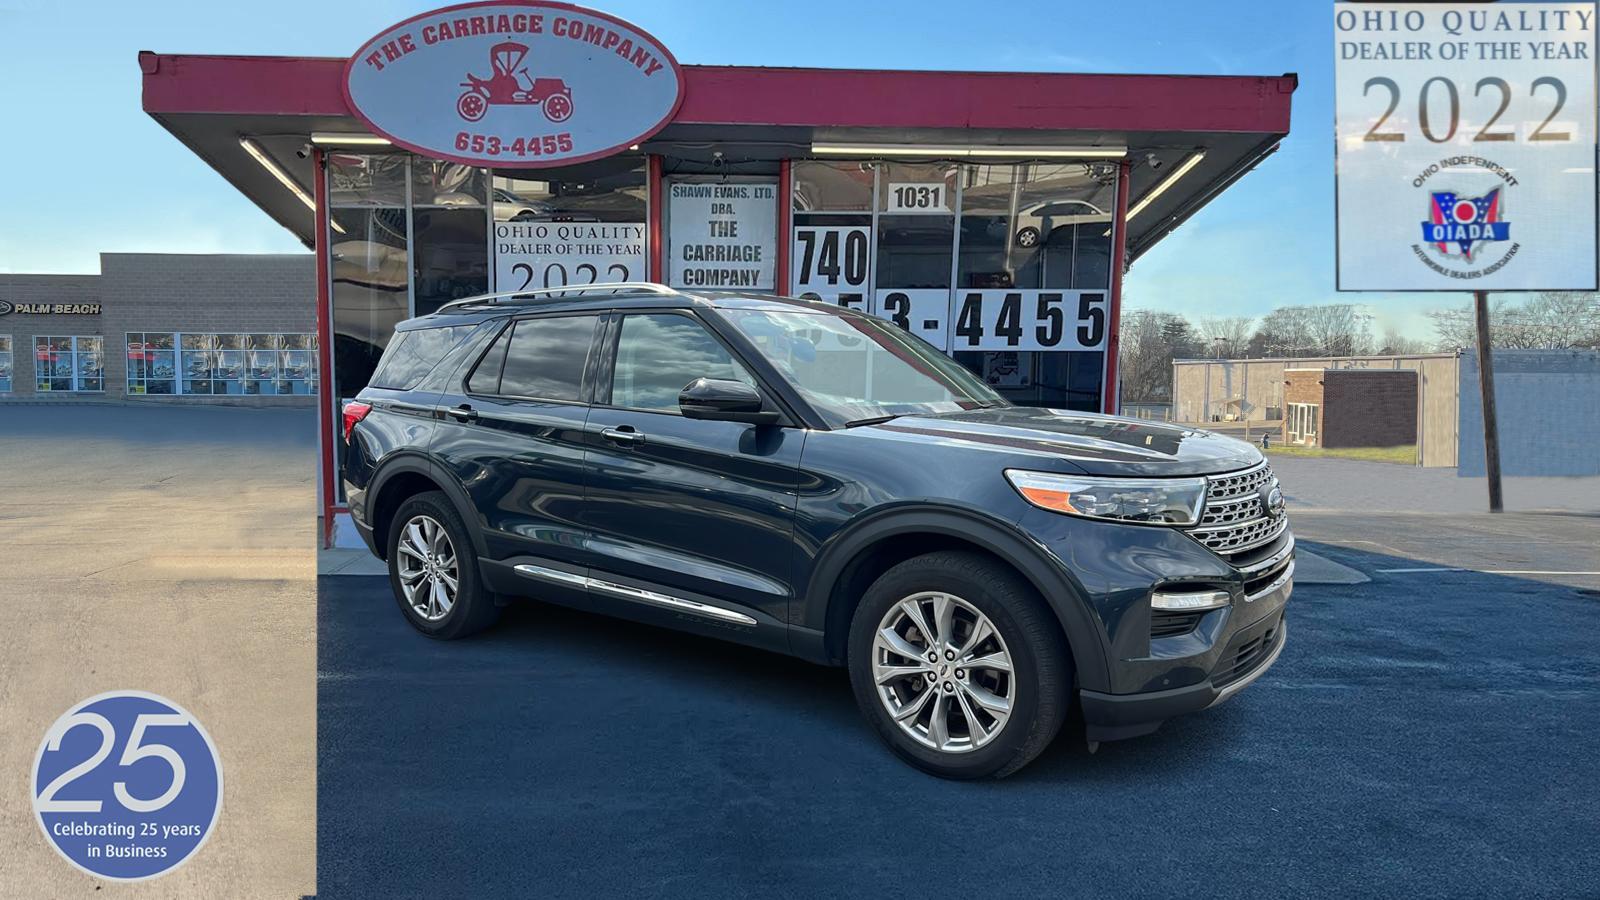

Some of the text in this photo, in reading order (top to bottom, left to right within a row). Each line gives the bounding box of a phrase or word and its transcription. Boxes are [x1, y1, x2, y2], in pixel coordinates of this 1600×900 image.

[1336, 10, 1593, 35] OHIO QUALITY
[365, 14, 665, 78] THE CARRIAGE COMPANY
[1340, 41, 1589, 61] DEALER OF THE YEAR
[1362, 76, 1571, 143] 2022
[454, 132, 574, 157] 653-4455
[1412, 155, 1519, 188] OHIO INDEPENDENT
[672, 185, 712, 199] SHAWN
[754, 186, 775, 200] LTD.
[894, 186, 941, 208] 1031
[711, 203, 736, 215] DBA.
[497, 225, 644, 241] OHIO QUALITY
[708, 220, 738, 238] THE
[1432, 224, 1495, 241] OIADA
[499, 243, 642, 255] DEALER OF THE YEAR
[683, 244, 762, 262] CARRIAGE
[797, 229, 868, 286] 740
[1411, 242, 1521, 280] AUTOMOBILE DEALERS ASSOCIATION
[683, 268, 761, 286] COMPANY
[14, 303, 51, 315] PALM
[54, 303, 101, 315] BEACH
